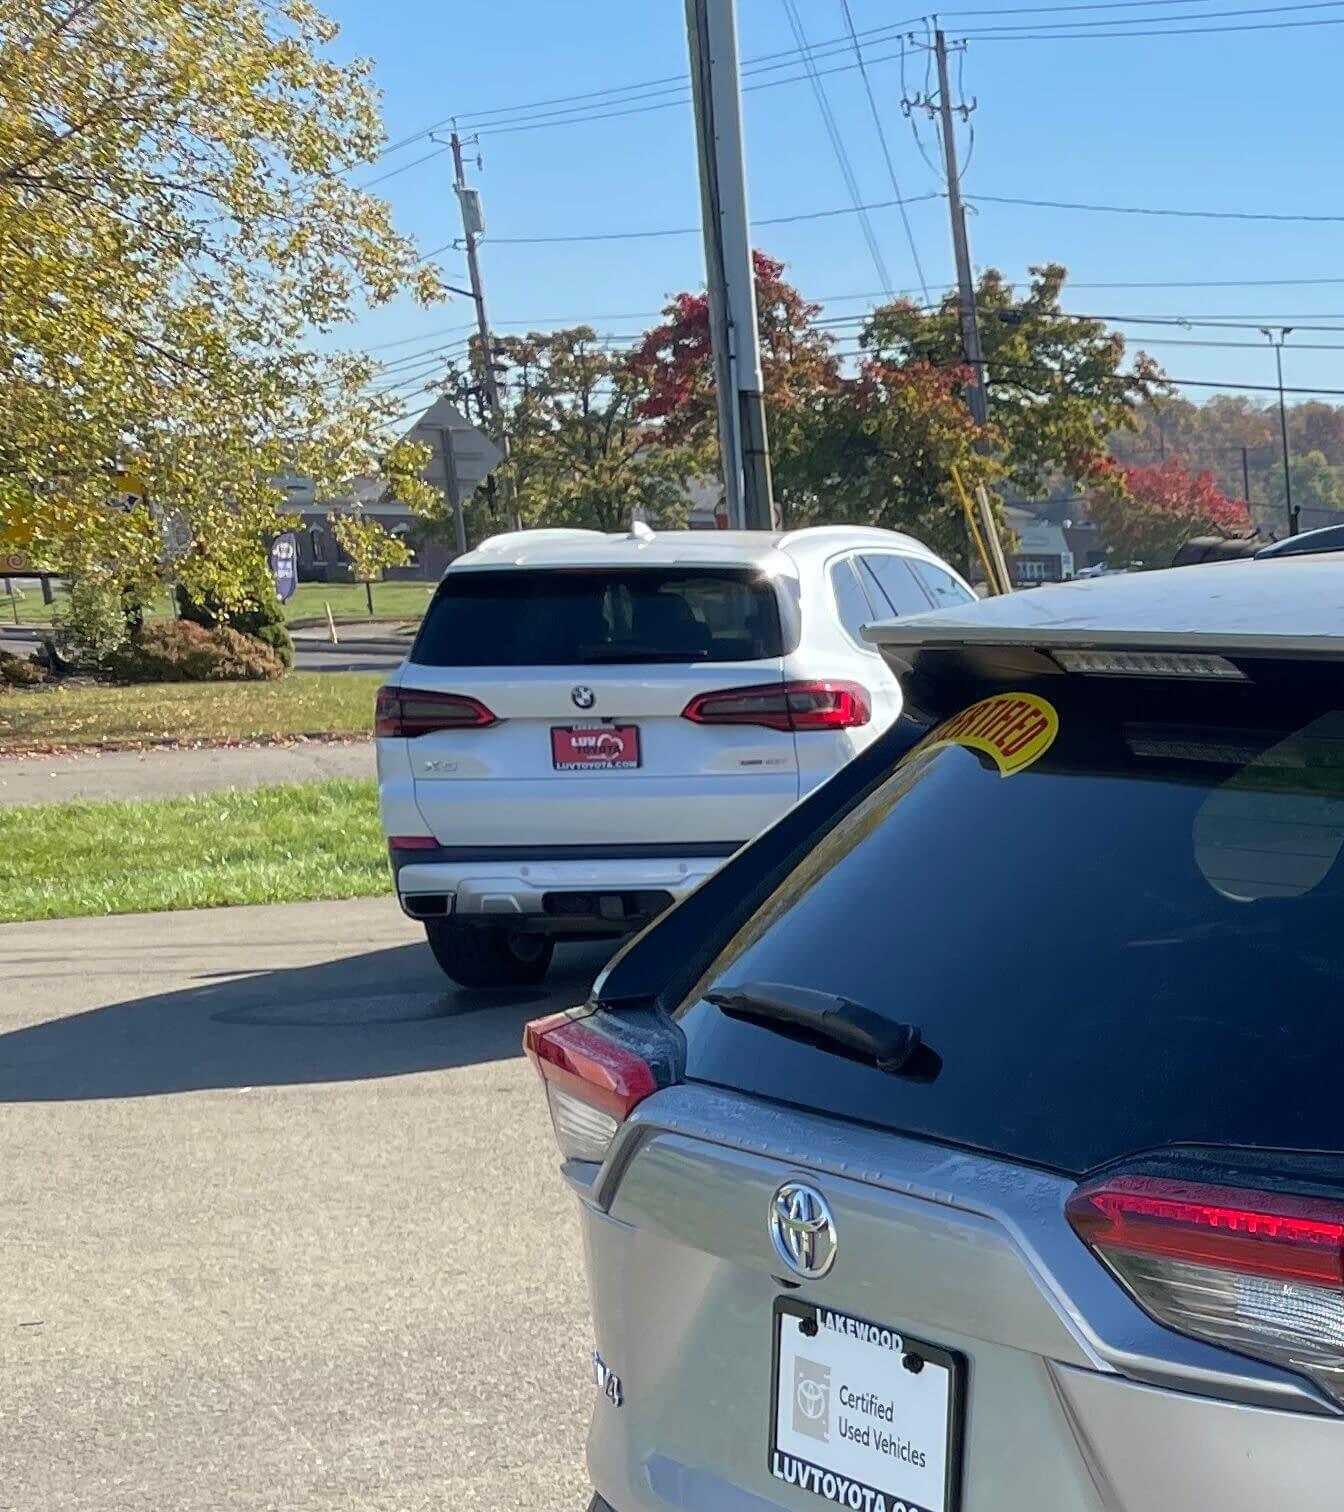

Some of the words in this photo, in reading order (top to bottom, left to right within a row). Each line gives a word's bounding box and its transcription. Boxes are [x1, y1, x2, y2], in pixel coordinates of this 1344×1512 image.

[571, 737, 596, 747] LUV
[556, 760, 637, 770] LUVTOYOTA.COM
[816, 1308, 904, 1354] LAKEWOOD
[839, 1384, 895, 1423] Certified
[838, 1416, 871, 1448] Used
[872, 1425, 927, 1469] Vehicles
